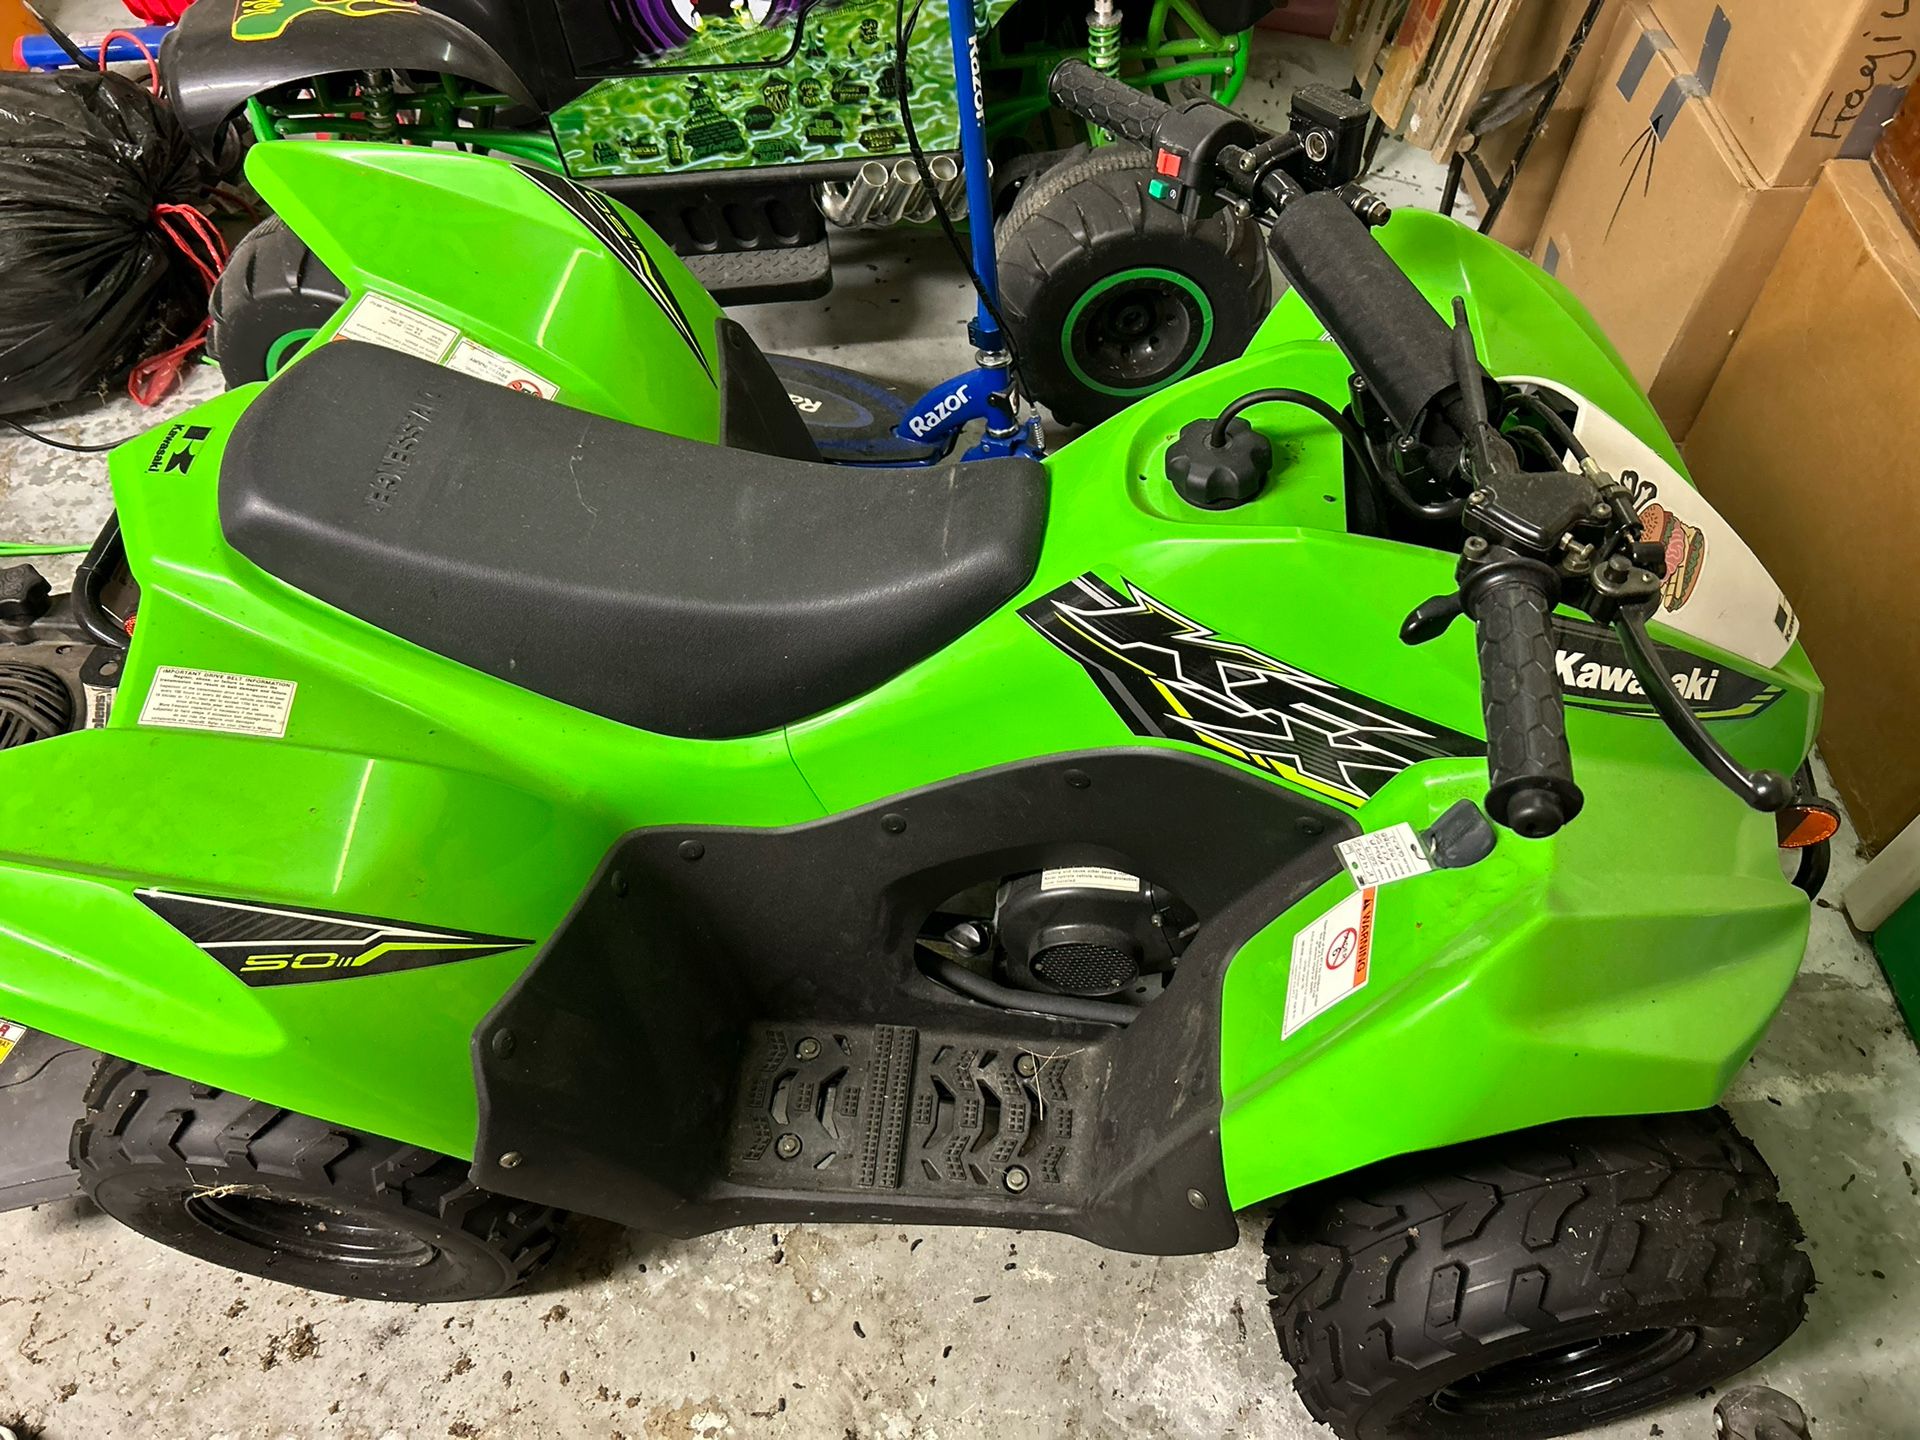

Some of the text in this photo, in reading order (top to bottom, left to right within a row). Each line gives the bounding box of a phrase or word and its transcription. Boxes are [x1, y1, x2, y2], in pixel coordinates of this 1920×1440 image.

[908, 384, 968, 437] Razor
[147, 423, 186, 473] Kawasaki
[162, 668, 202, 677] IMPORTANT
[245, 677, 291, 688] INFORMATION
[1555, 649, 1719, 701] Kawaaki
[240, 953, 339, 972] 50
[1356, 910, 1371, 973] WARNING
